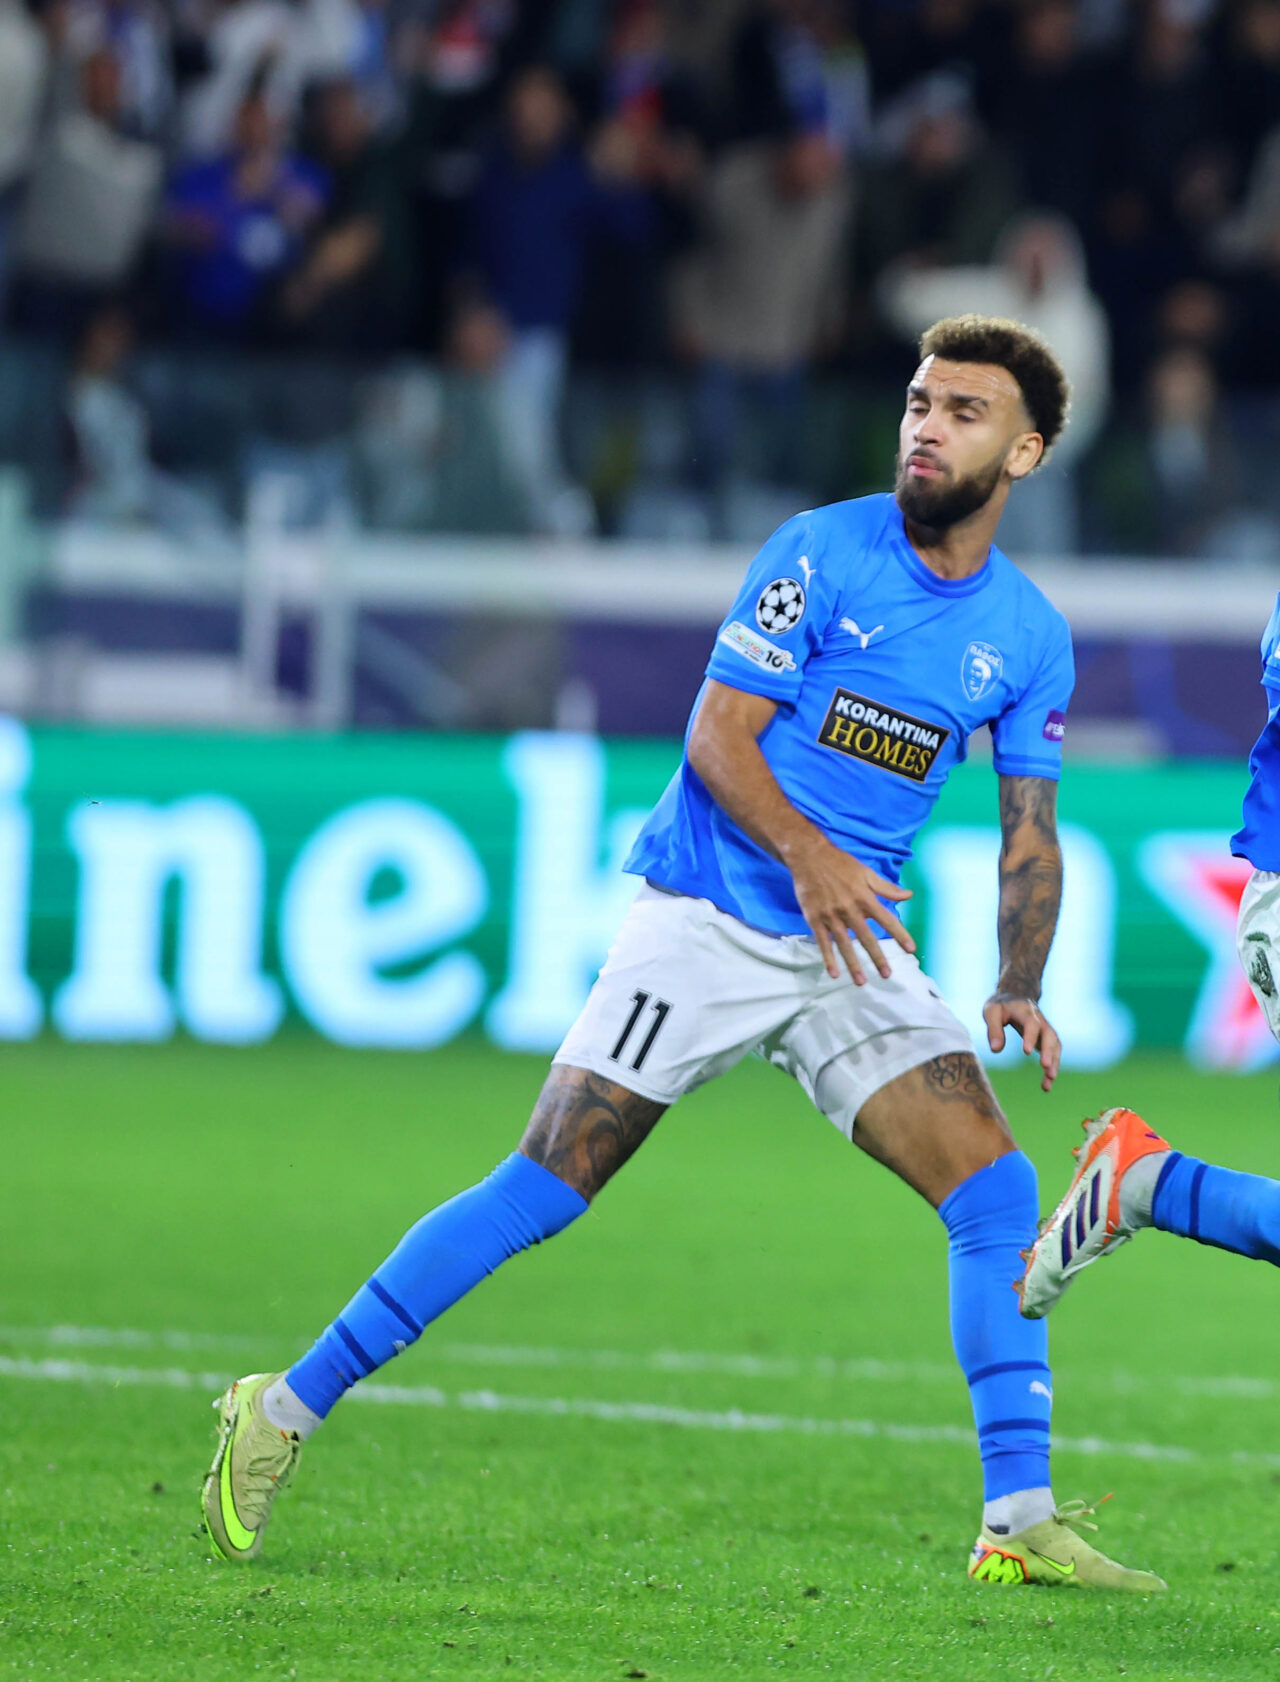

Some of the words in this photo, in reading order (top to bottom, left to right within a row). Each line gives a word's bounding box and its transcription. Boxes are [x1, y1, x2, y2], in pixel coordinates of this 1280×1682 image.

[827, 715, 932, 775] HOMES
[834, 696, 940, 750] KORANTINA
[607, 988, 674, 1073] 11
